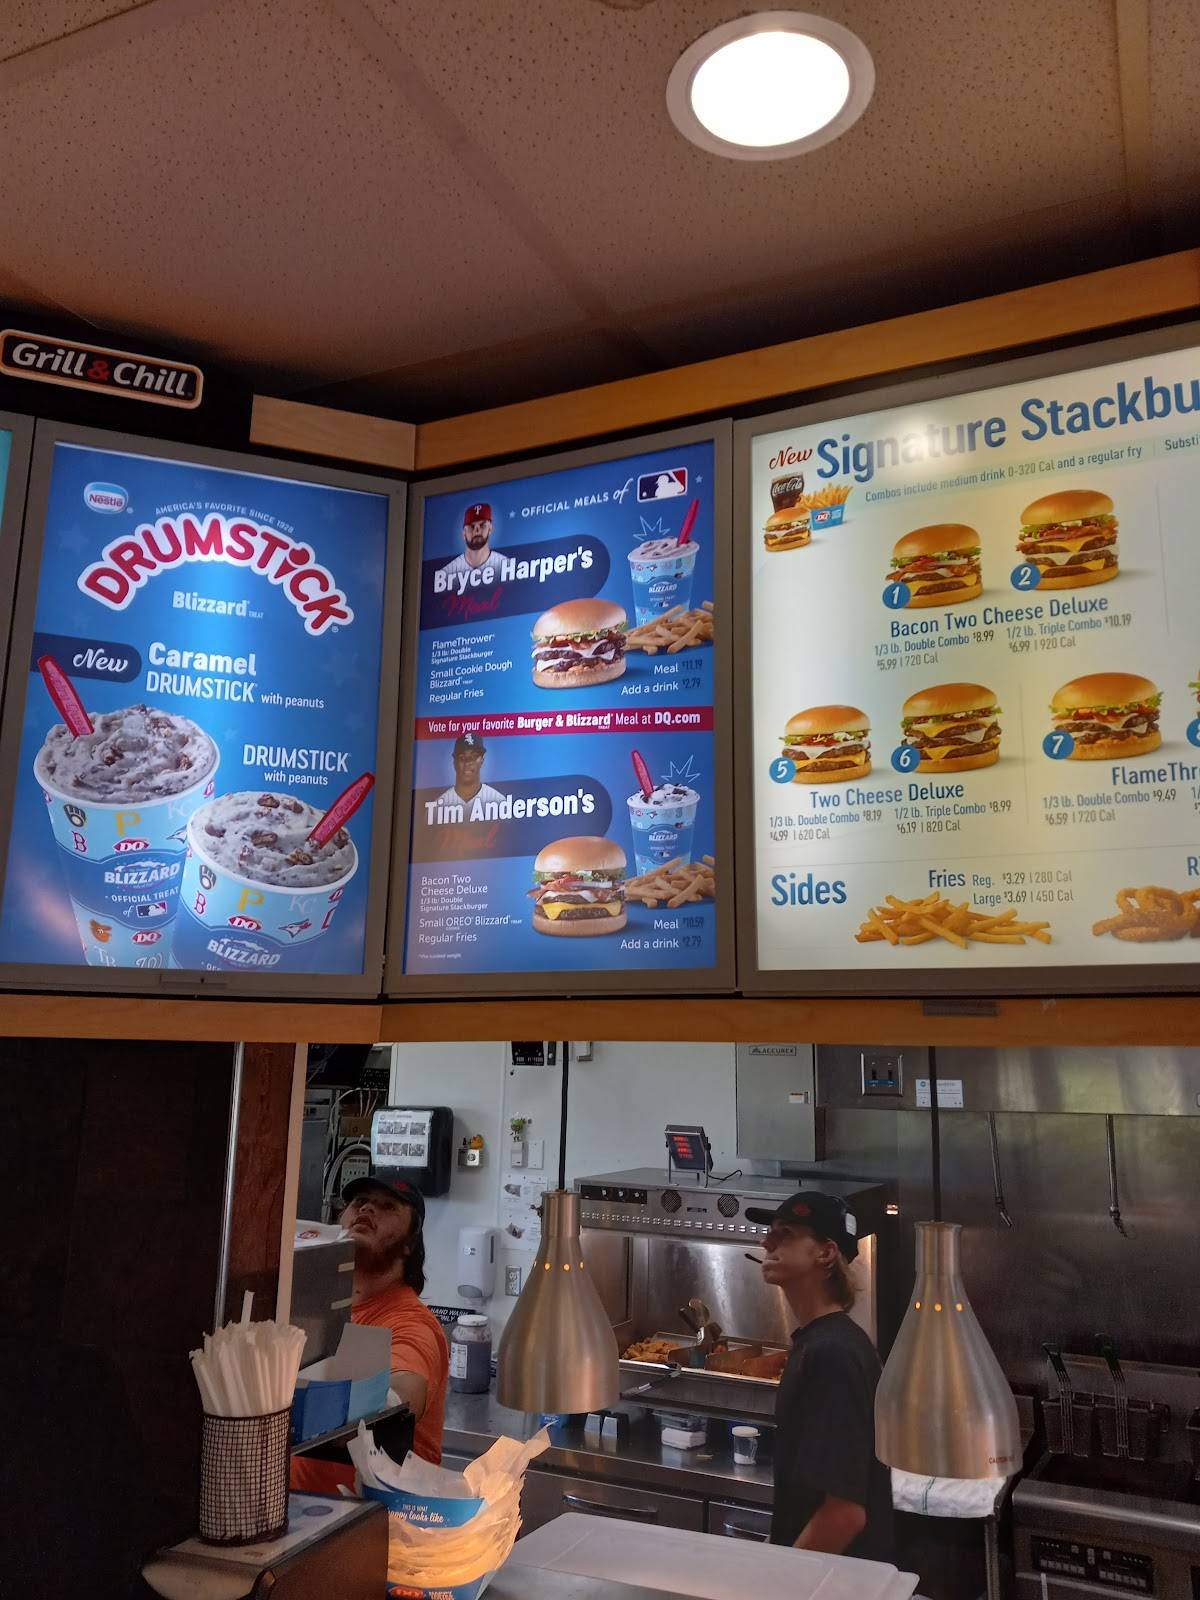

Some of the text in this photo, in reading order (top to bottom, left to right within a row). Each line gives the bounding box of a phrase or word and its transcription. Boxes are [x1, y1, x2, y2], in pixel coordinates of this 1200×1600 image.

[12, 342, 188, 396] Grill & Chill
[817, 376, 1199, 482] Signature Stackbu
[769, 446, 813, 470] New
[865, 488, 901, 502] Combos
[904, 481, 938, 496] include
[940, 474, 978, 490] medium
[980, 468, 1006, 482] drink
[1008, 463, 1036, 478] 0-320
[1039, 460, 1056, 473] Cal
[1057, 456, 1076, 470] and
[1087, 448, 1125, 465] regular
[1127, 445, 1142, 459] fry
[521, 478, 634, 518] OFFICIAL MEALS of
[155, 501, 203, 515] AMERICA'S
[205, 502, 246, 515] FAVORITE
[249, 507, 275, 523] SINCE
[434, 546, 593, 596] Bryce Harper's
[1019, 567, 1030, 586] 2
[172, 590, 249, 617] Blizzard
[890, 596, 1108, 638] Bacon Two Cheese Deluxe
[1006, 626, 1021, 639] 1/2
[1024, 625, 1036, 636] lb.
[1039, 622, 1066, 636] Triple
[1068, 617, 1102, 631] Combo
[432, 634, 493, 650] FlameThrower
[874, 629, 994, 656] 1/3 lb. Double Combo $8.99
[1040, 637, 1058, 650] 920
[1060, 635, 1076, 648] Cal
[73, 648, 129, 673] New
[148, 642, 256, 677] Caramel
[431, 650, 493, 665] Signature Stackburger
[905, 654, 921, 666] 720
[923, 652, 939, 664] Cal
[430, 660, 512, 679] Small Cookie Dough
[654, 662, 679, 675] Meal
[146, 671, 325, 709] DRUMSTICK with peanuts
[430, 678, 461, 689] Blizzard
[621, 680, 679, 696] Add a drink
[429, 688, 484, 704] Regular Fries
[428, 711, 701, 734] Vote for your favorite Burger & Blizzard Meal at DQ.com
[1052, 735, 1064, 752] 7
[243, 744, 349, 773] DRUMSTICK
[900, 749, 911, 767] 6
[264, 770, 329, 787] with peanuts
[776, 760, 788, 779] 5
[1111, 761, 1200, 786] FlameThr
[810, 782, 964, 808] Two Cheese Deluxe
[1043, 796, 1059, 809] 1/3
[1061, 796, 1074, 808] lb.
[1077, 793, 1112, 806] Double
[1114, 790, 1150, 804] Combo
[1152, 788, 1176, 802] $9.49
[425, 788, 595, 825] Tim Anderson's
[895, 799, 1011, 820] 1/2 lb. Triple Combo $8.99
[1078, 808, 1116, 823] 720 Cal
[769, 811, 860, 828] 1/3 lb. Double Combo
[897, 819, 961, 834] $6.19 820 Cal
[816, 828, 830, 840] Cal
[104, 863, 181, 885] BLIZZARD
[421, 875, 471, 886] Bacon Two
[929, 869, 1072, 888] Fries Reg. $3.29 280 Cal
[111, 887, 179, 902] OFFICIAL TREAT
[421, 884, 488, 896] Cheese Deluxe
[771, 872, 847, 906] Sides
[973, 889, 1074, 907] Large $3.69 450 Cal
[420, 903, 488, 912] Signature Stackburger
[440, 896, 463, 904] Double
[419, 915, 509, 928] Small OREO Blizzard
[653, 918, 679, 930] Meal
[418, 932, 477, 945] Regular Fries
[620, 937, 679, 949] Add a drink
[207, 939, 281, 966] BLIZZARD
[429, 1512, 444, 1523] like
